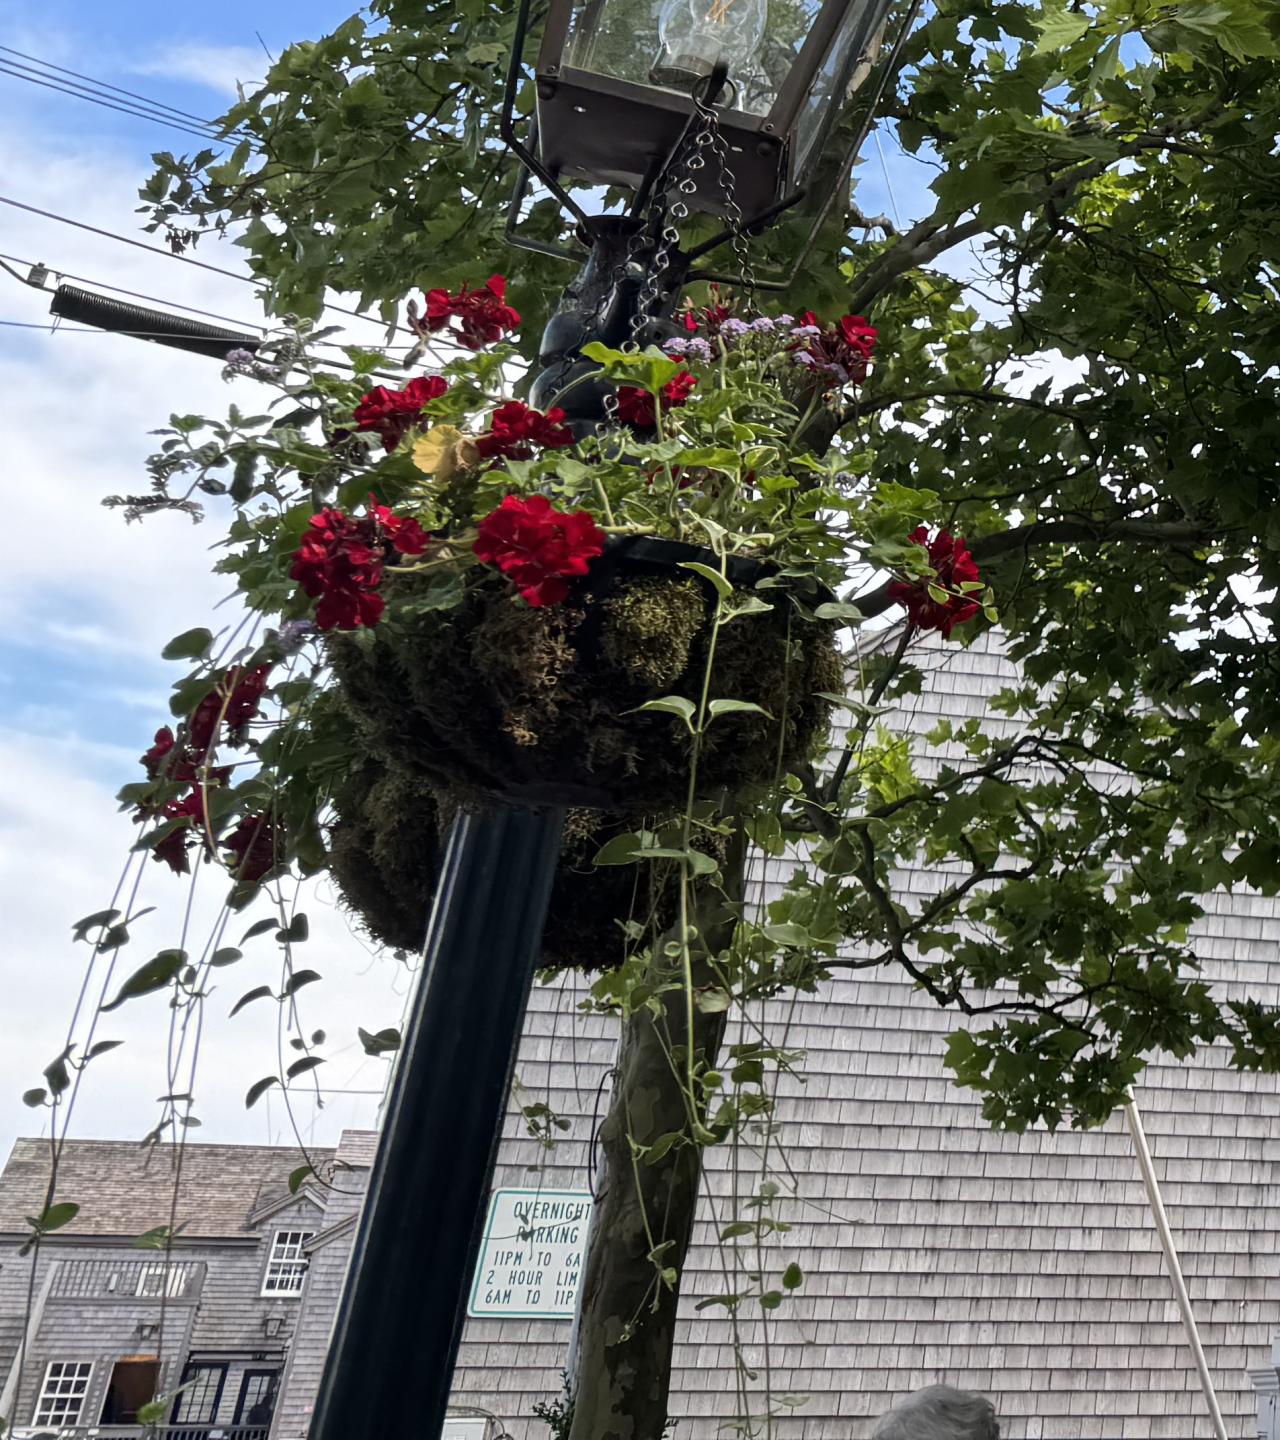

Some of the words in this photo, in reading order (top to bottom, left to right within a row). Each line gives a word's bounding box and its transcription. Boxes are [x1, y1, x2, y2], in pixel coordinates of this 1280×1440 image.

[513, 1201, 592, 1220] OVERNIGHT
[494, 1251, 523, 1266] 11PM
[537, 1252, 552, 1266] TO
[565, 1252, 580, 1267] 6A
[486, 1270, 495, 1285] 2
[508, 1270, 543, 1286] HOUR
[556, 1271, 578, 1286] LIM
[485, 1289, 512, 1305] 6AM
[526, 1290, 541, 1305] TO
[554, 1291, 576, 1306] 11P
